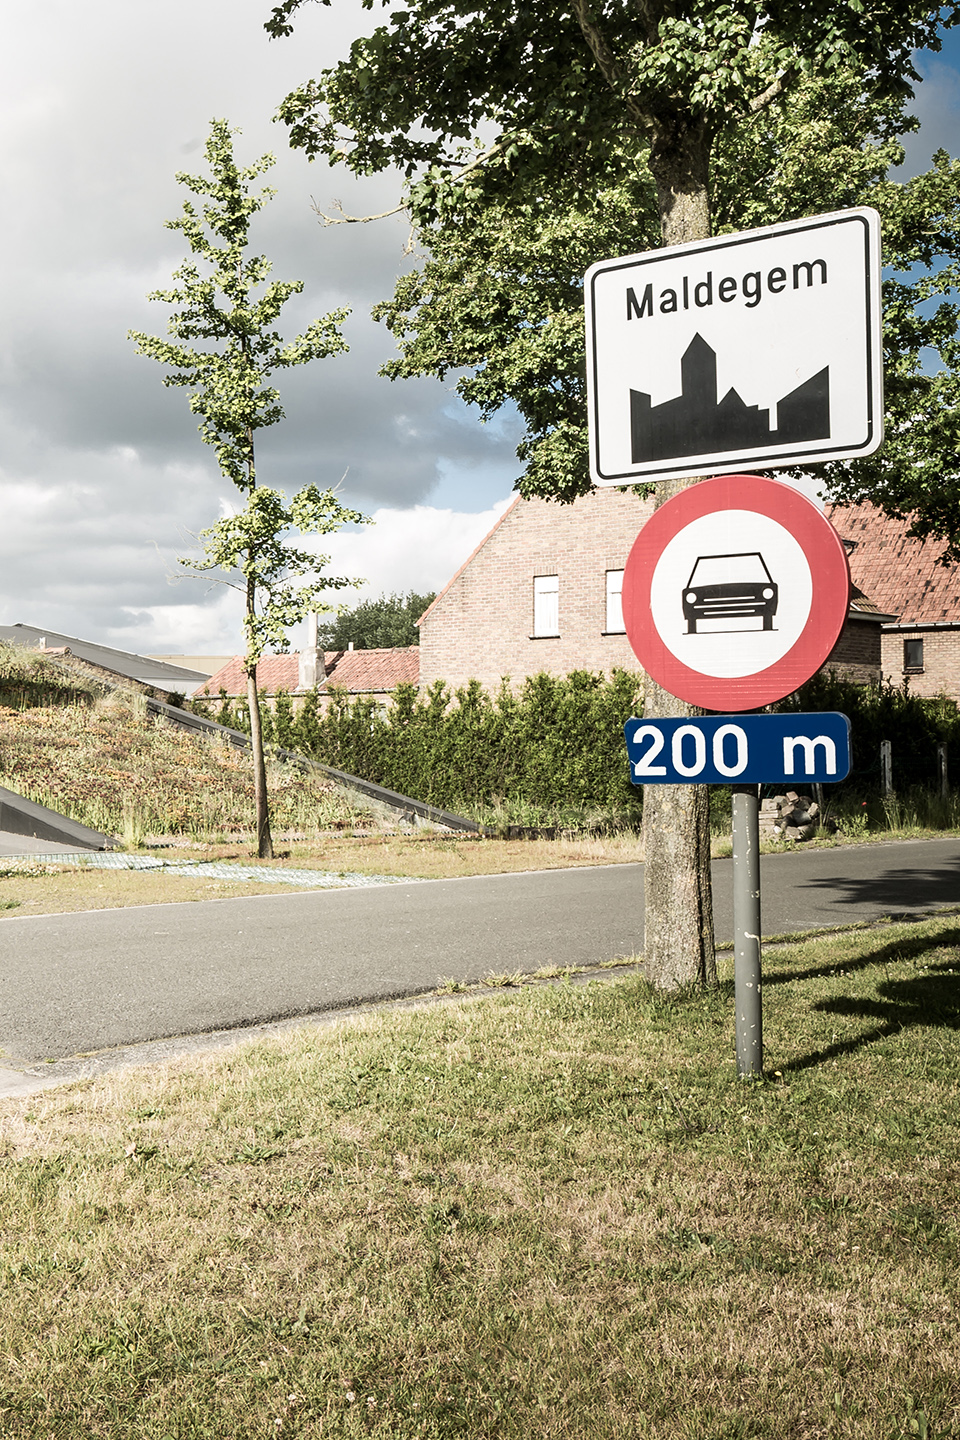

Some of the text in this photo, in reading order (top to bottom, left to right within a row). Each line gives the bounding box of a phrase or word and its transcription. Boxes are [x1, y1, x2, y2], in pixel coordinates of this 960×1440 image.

[626, 258, 828, 321] Maldegem
[632, 724, 837, 777] 200 m
